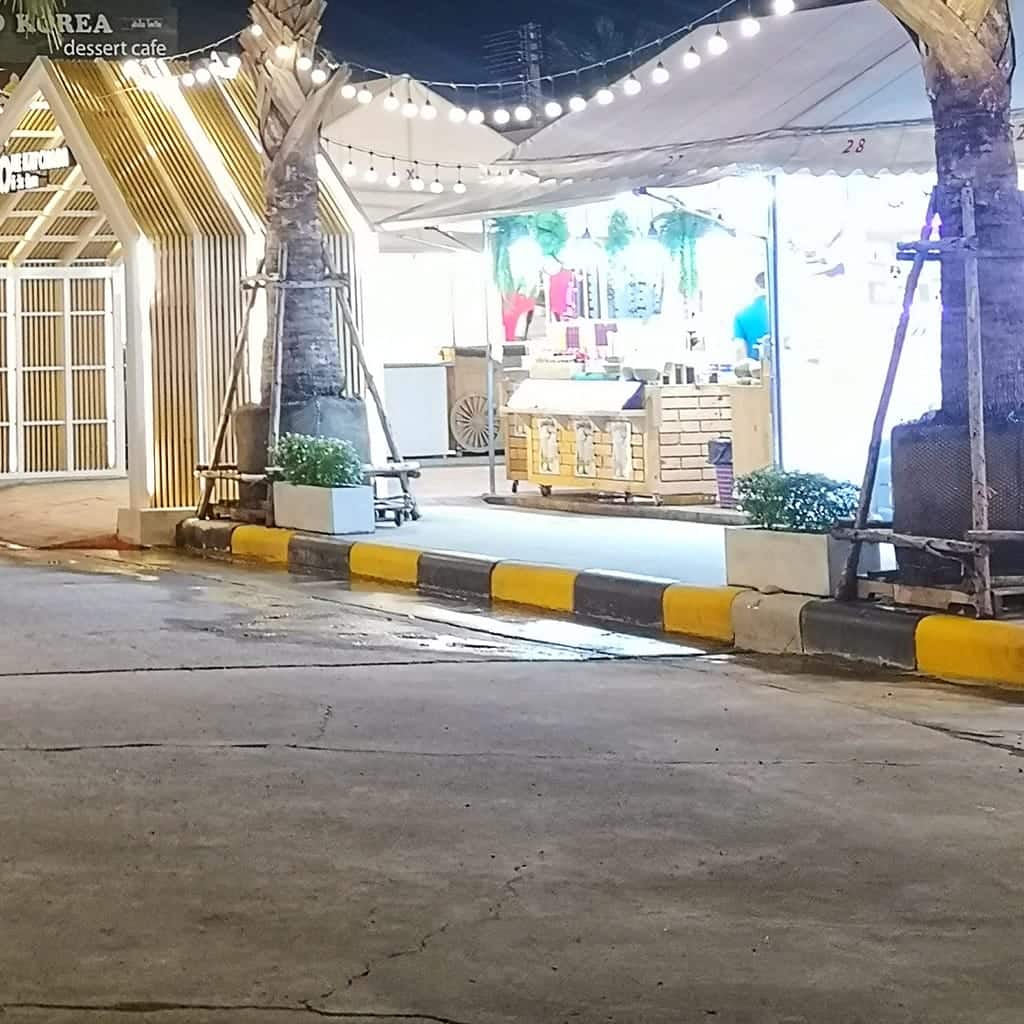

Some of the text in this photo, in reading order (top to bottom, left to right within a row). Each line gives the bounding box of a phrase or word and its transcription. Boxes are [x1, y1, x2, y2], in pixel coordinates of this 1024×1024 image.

[63, 38, 168, 57] dessert cafe
[842, 137, 866, 154] 28
